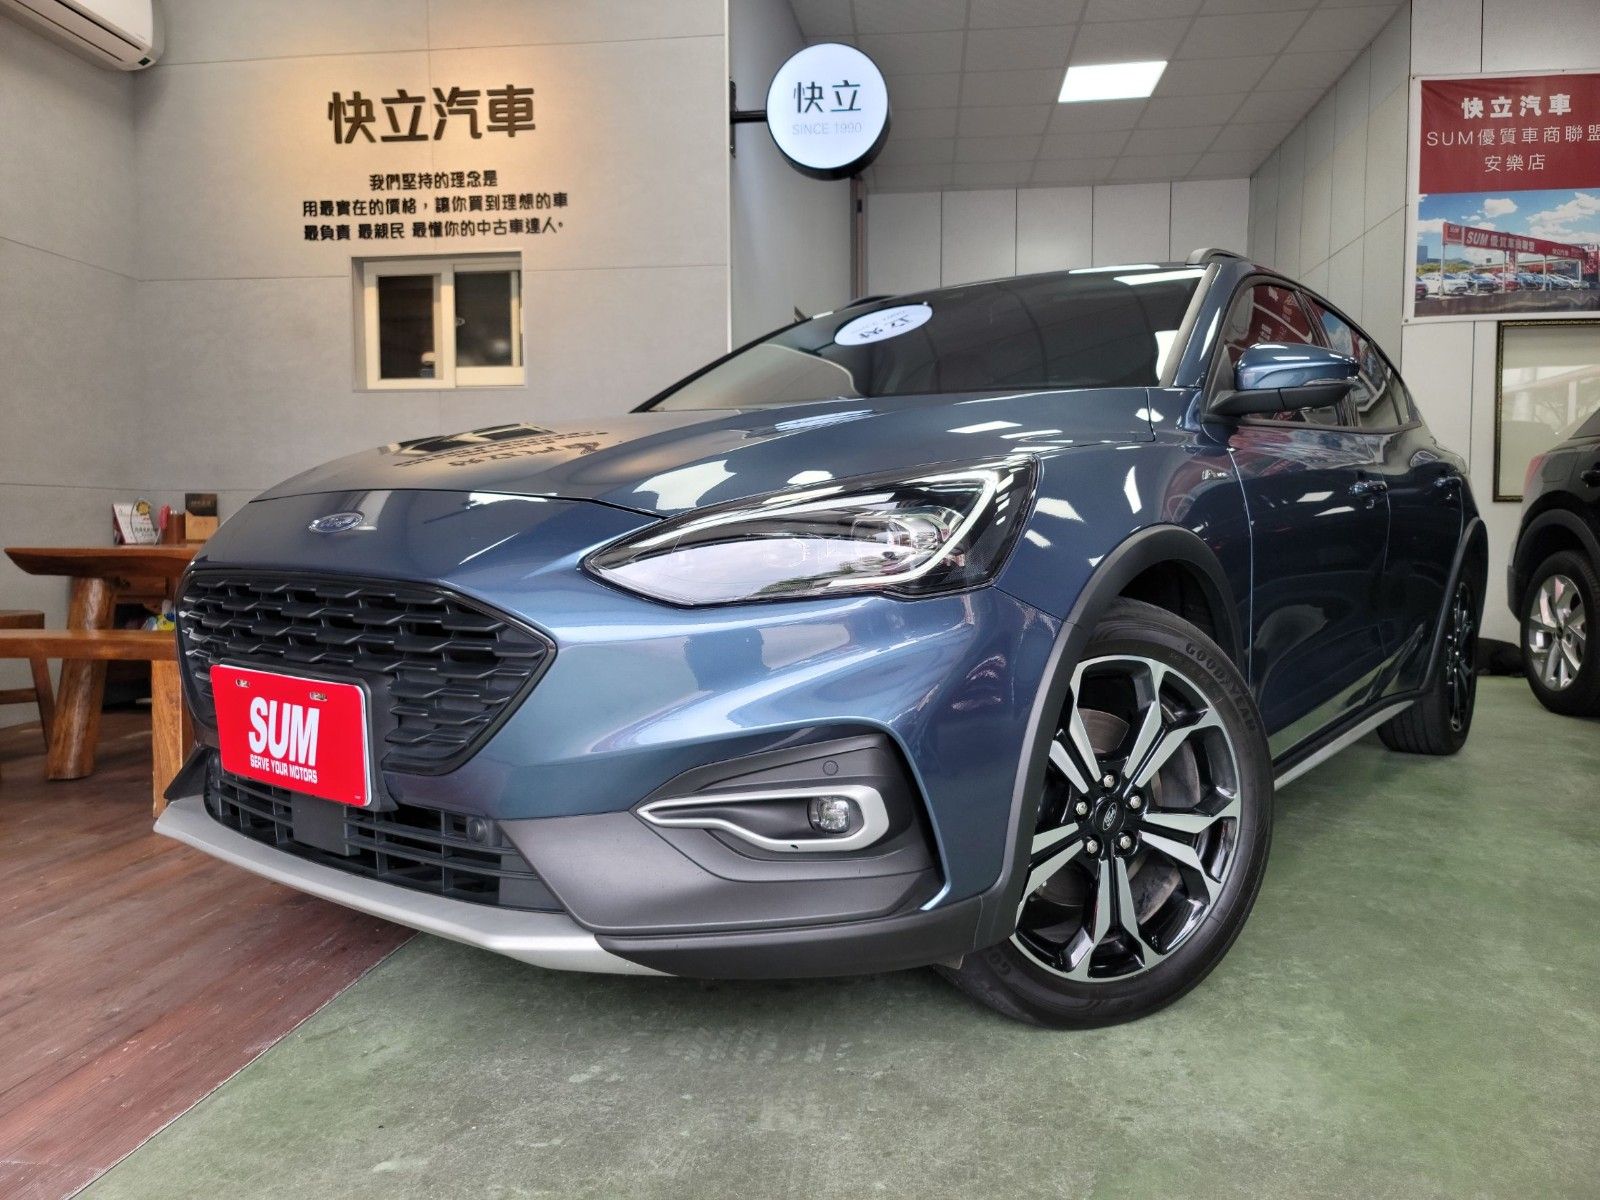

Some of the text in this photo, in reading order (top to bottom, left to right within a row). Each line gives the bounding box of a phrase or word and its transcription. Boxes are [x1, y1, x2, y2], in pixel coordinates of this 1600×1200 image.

[793, 80, 862, 113] 快立
[1461, 94, 1572, 119] 快立汽車
[328, 84, 536, 144] 快立汽車
[792, 122, 862, 135] SINCE 1990
[1484, 153, 1546, 172] 安樂店
[369, 170, 498, 191] 我們堅持的理念是
[248, 697, 320, 766] SUM
[250, 754, 318, 784] SERVE YOUR MOTORS
